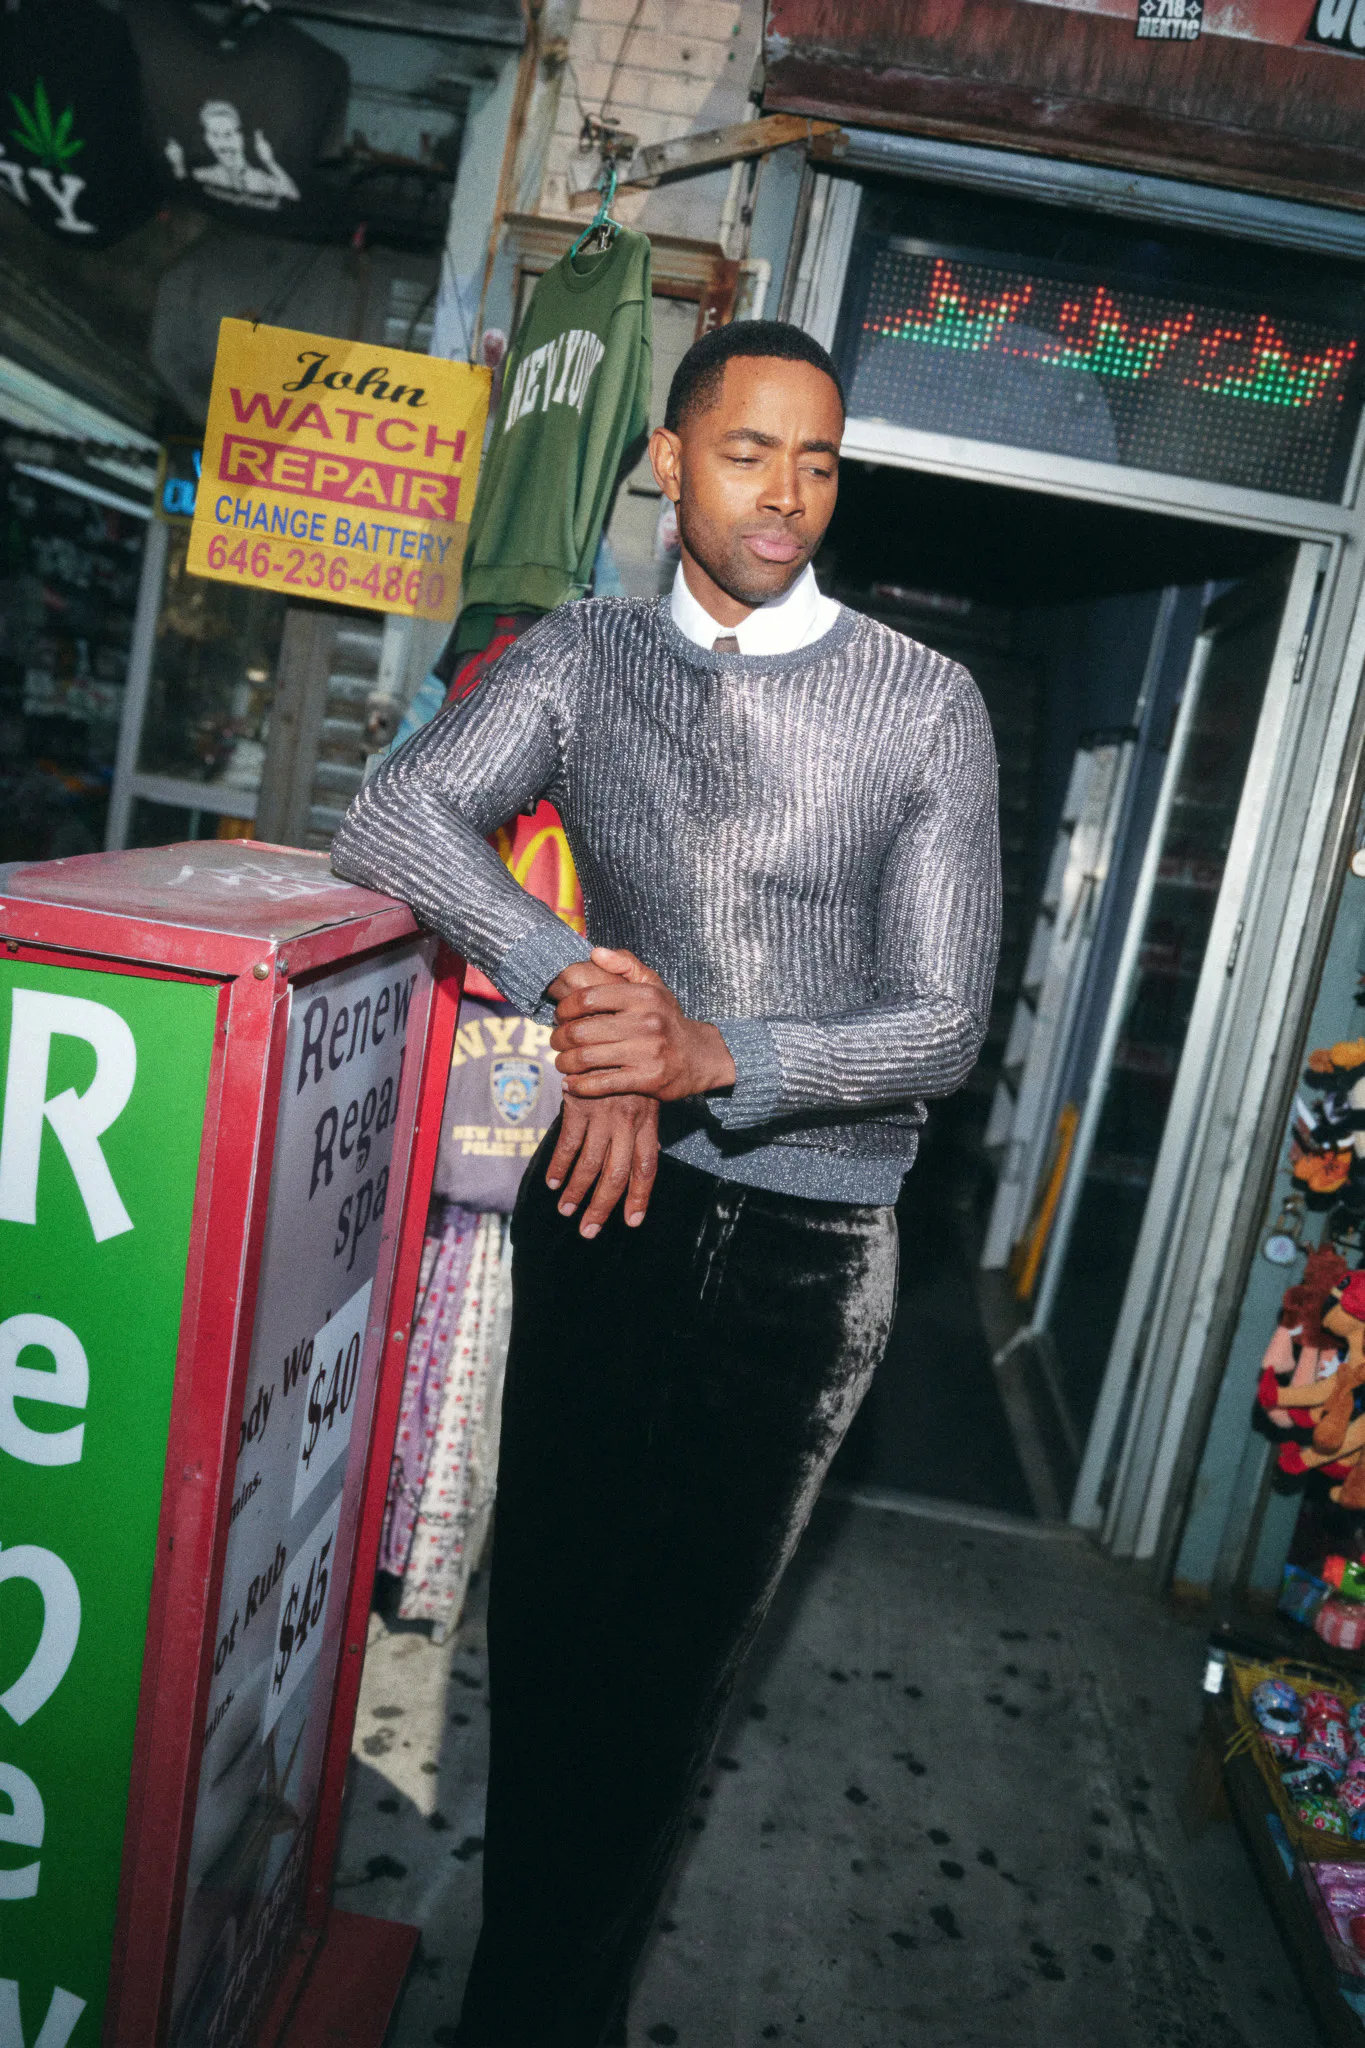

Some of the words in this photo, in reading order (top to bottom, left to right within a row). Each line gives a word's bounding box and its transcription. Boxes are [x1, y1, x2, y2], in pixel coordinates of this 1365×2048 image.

[1137, 16, 1200, 39] HEKTIC
[1157, 0, 1186, 17] 718
[282, 351, 428, 407] John
[229, 387, 467, 463] WATCH
[226, 442, 453, 517] REPAIR
[215, 495, 327, 542] CHANGE
[333, 517, 452, 564] BATTERY
[207, 534, 445, 609] 646-236-4860
[297, 974, 417, 1095] Renew
[334, 1164, 390, 1273] spa
[302, 1332, 360, 1471] $40
[244, 1540, 287, 1631] Rub
[272, 1531, 334, 1696] $45
